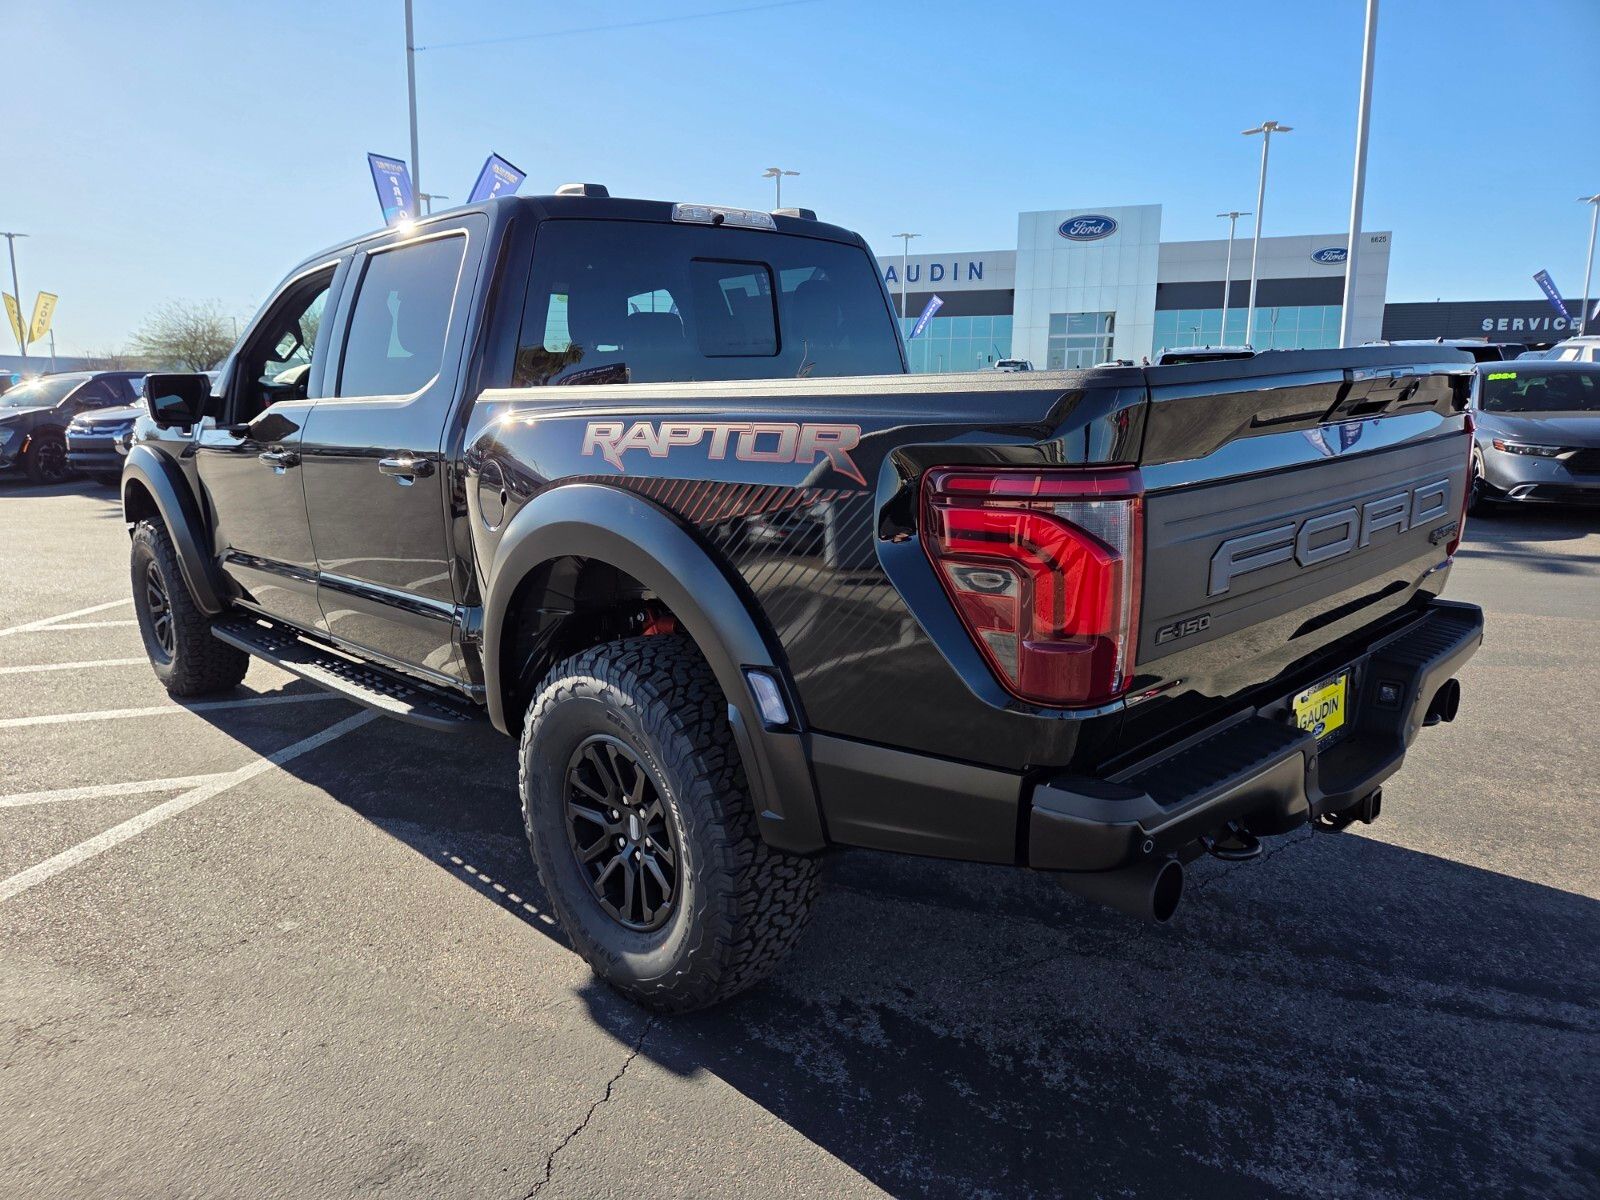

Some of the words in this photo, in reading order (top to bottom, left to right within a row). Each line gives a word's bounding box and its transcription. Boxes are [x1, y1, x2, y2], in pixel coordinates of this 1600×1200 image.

[1070, 219, 1105, 235] Ford
[1321, 250, 1346, 261] Ford
[884, 261, 984, 283] AUDIN
[1481, 317, 1583, 332] SERVICE
[580, 421, 868, 487] RAPTOR
[1206, 478, 1449, 598] FORD
[1154, 612, 1211, 647] F-150
[1300, 695, 1339, 729] GAUDIN
